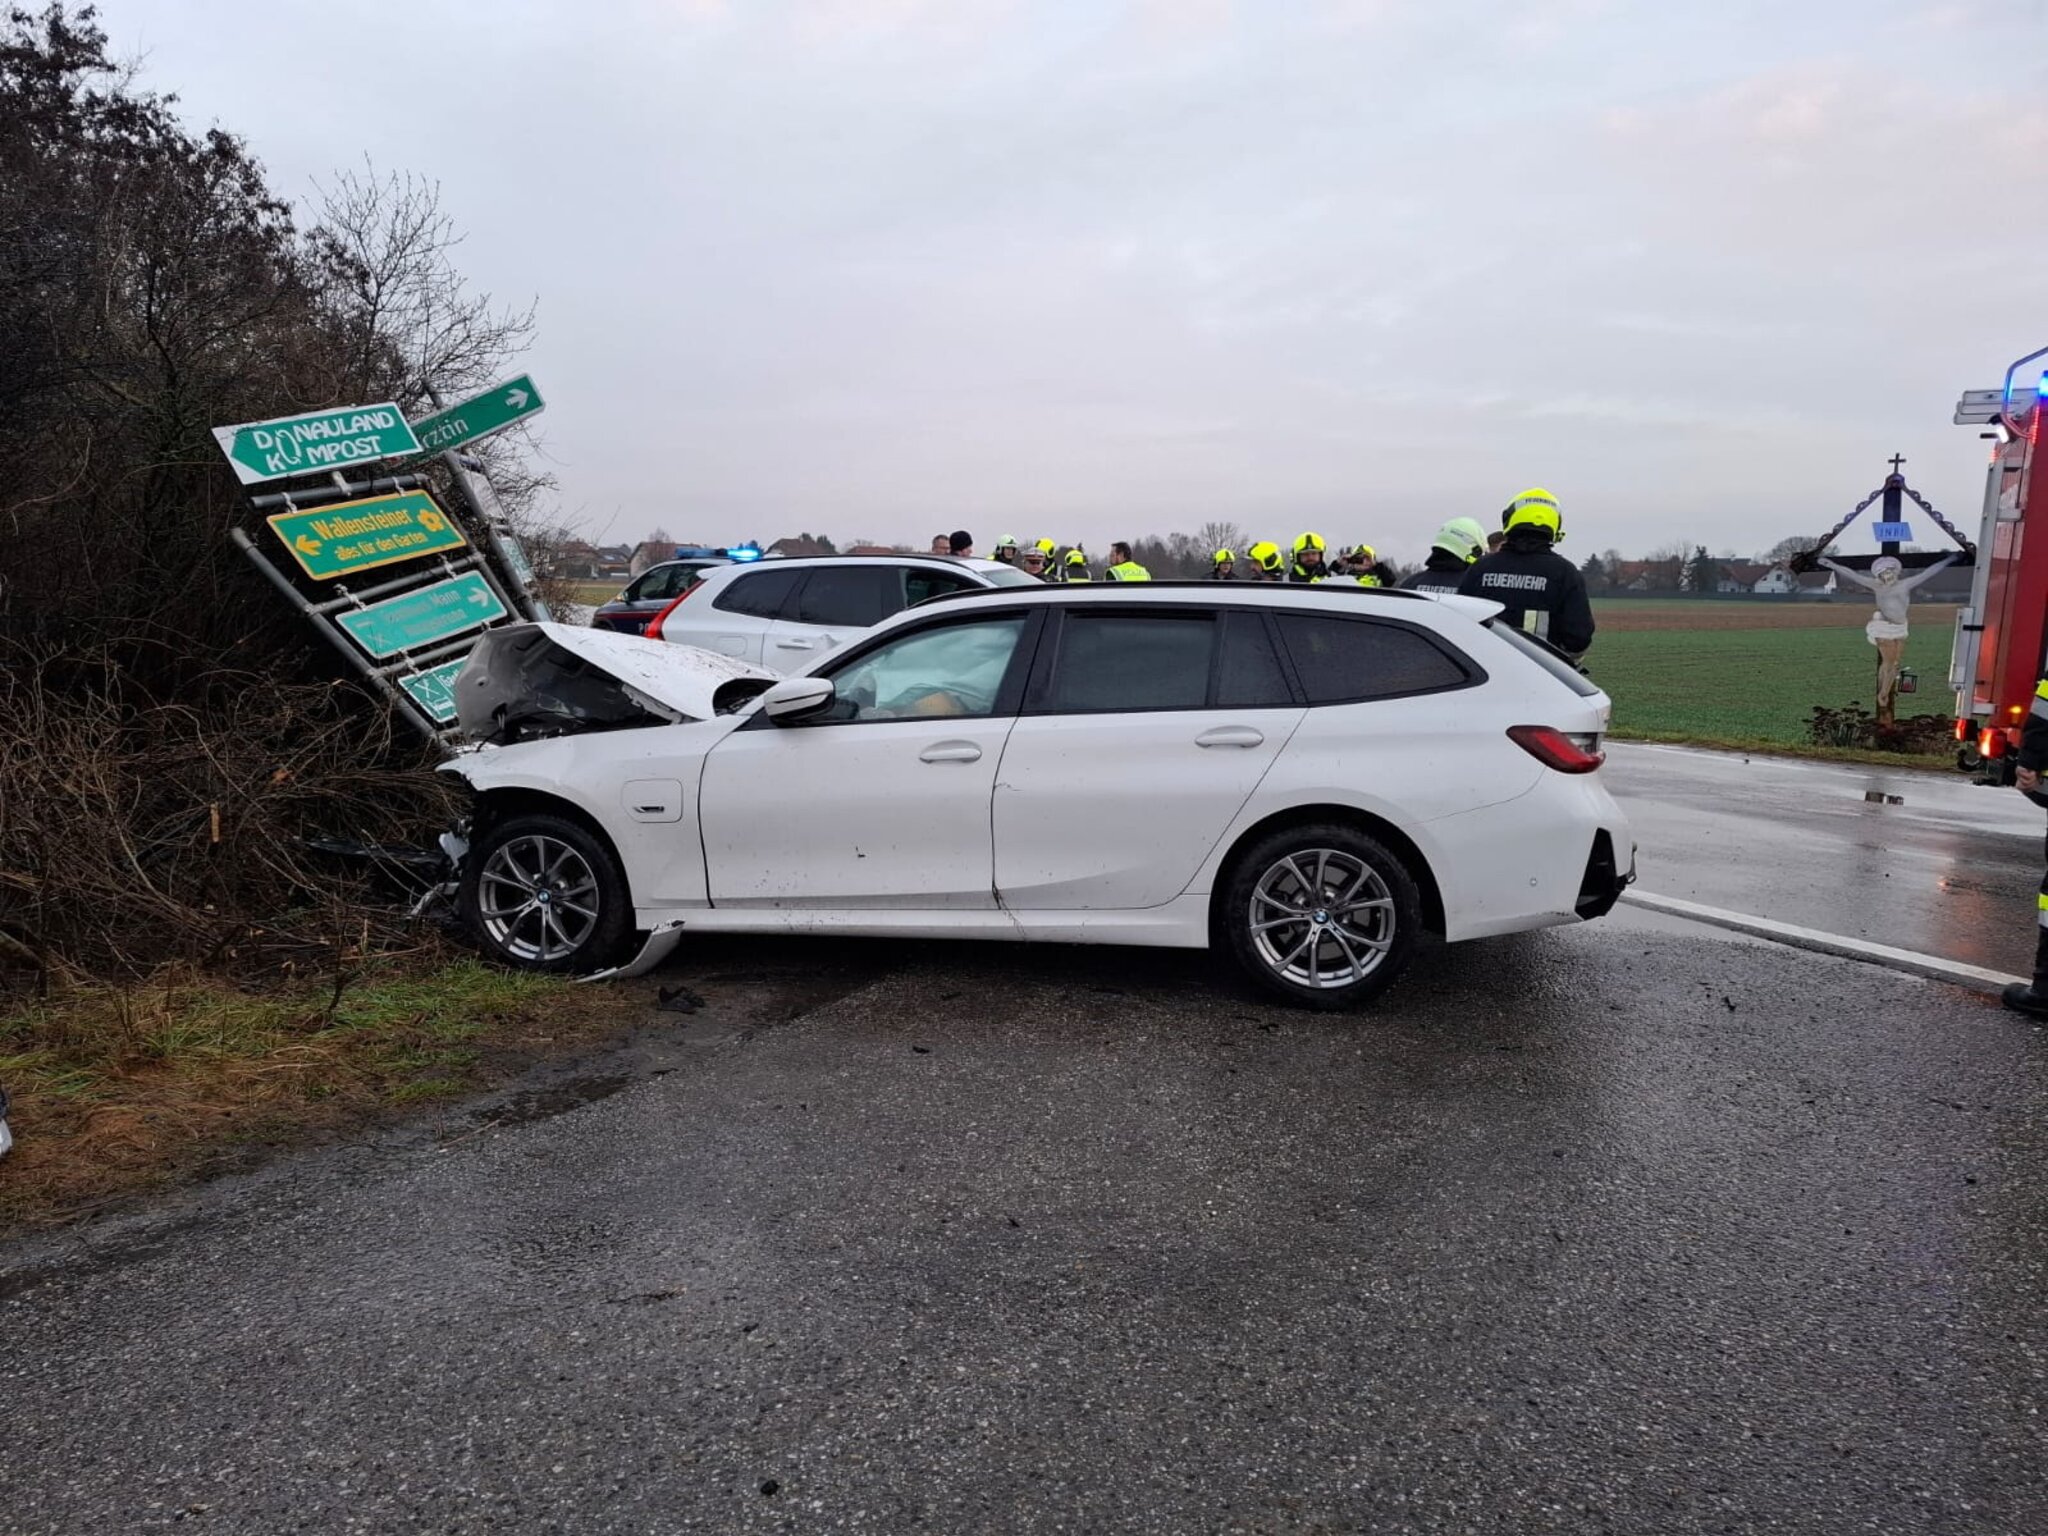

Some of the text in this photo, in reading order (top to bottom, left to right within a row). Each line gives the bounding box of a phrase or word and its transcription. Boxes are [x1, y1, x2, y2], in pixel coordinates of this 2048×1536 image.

[252, 411, 395, 458] DONAULAND
[421, 418, 469, 448] rztin
[309, 509, 413, 540] Wallensteiner
[391, 532, 429, 548] Garten
[1416, 584, 1459, 595] FEUERWE
[1482, 573, 1547, 591] FEUERWEHR
